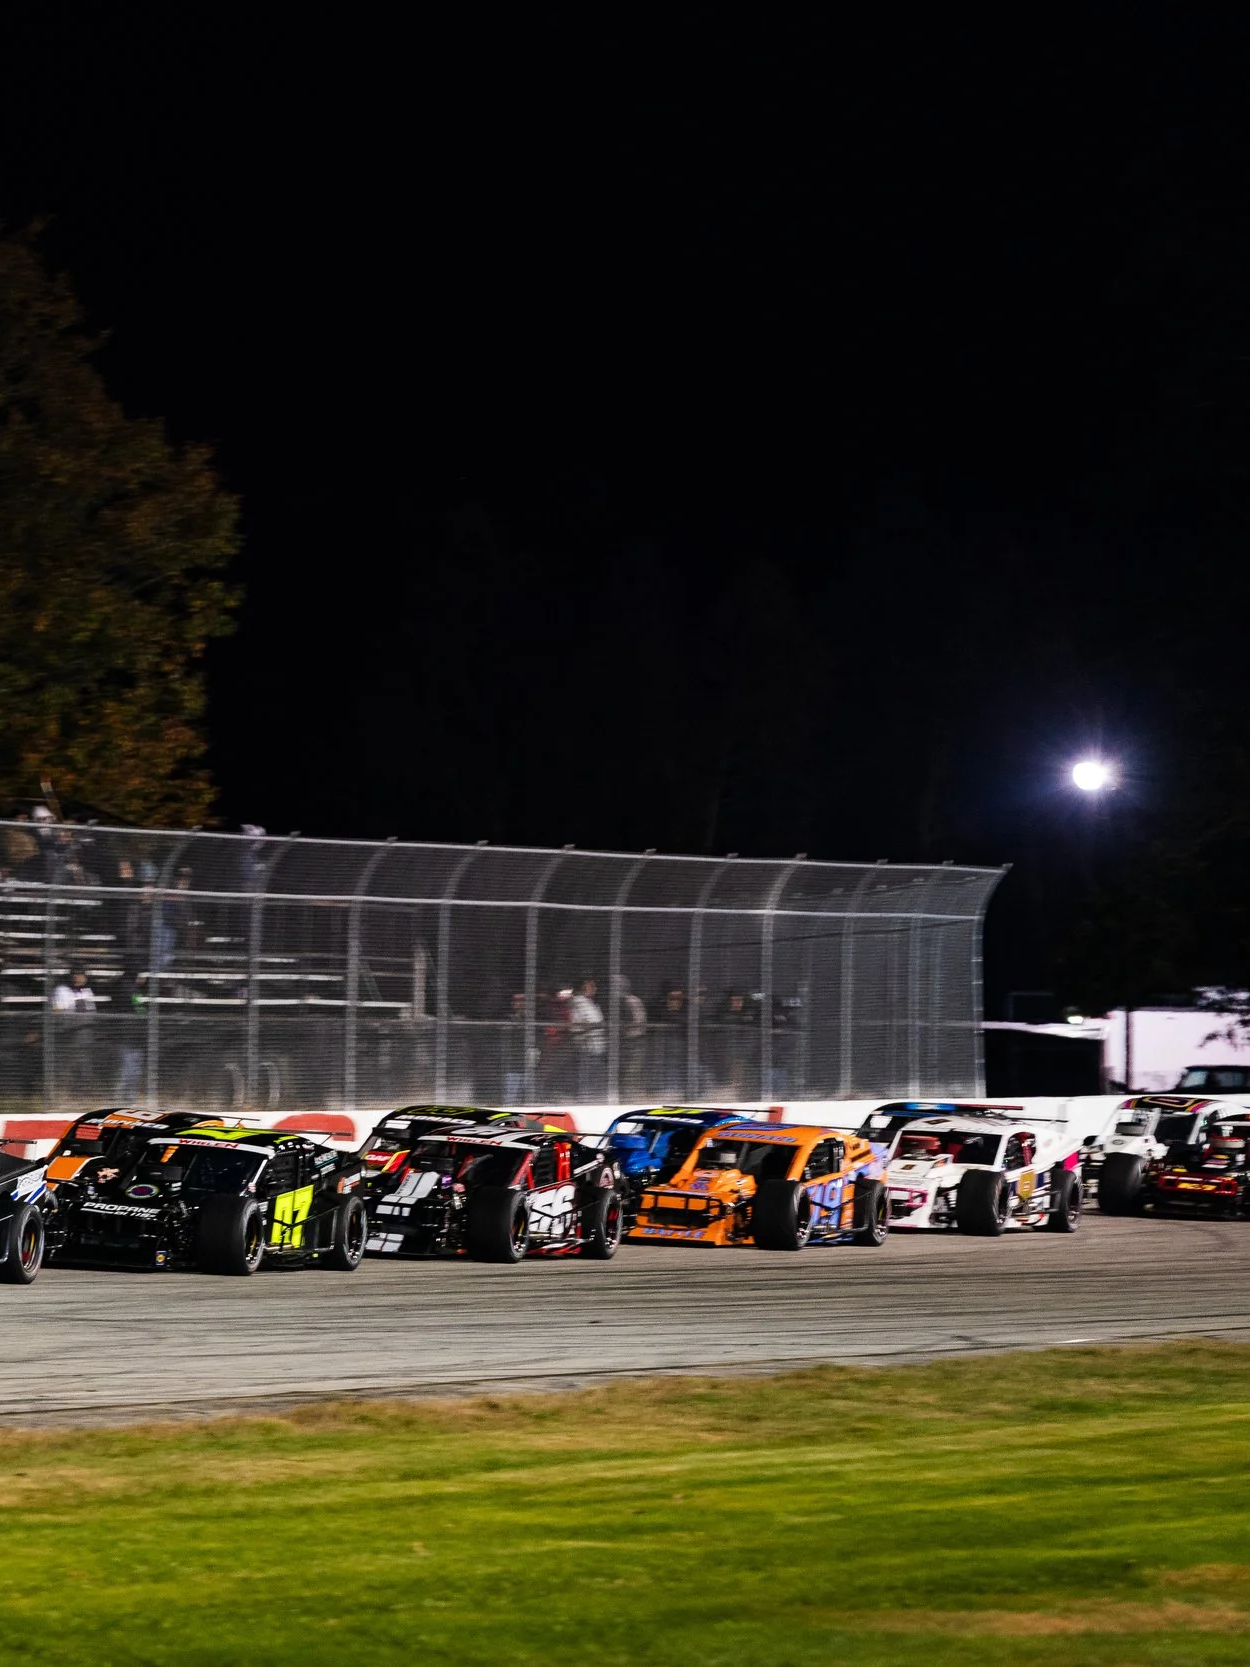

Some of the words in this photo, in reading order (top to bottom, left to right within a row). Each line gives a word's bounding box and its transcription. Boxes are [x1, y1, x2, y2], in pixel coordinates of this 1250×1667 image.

[178, 1138, 239, 1149] WHELEN
[446, 1136, 503, 1145] WHELEN
[83, 1201, 161, 1214] PROPANE
